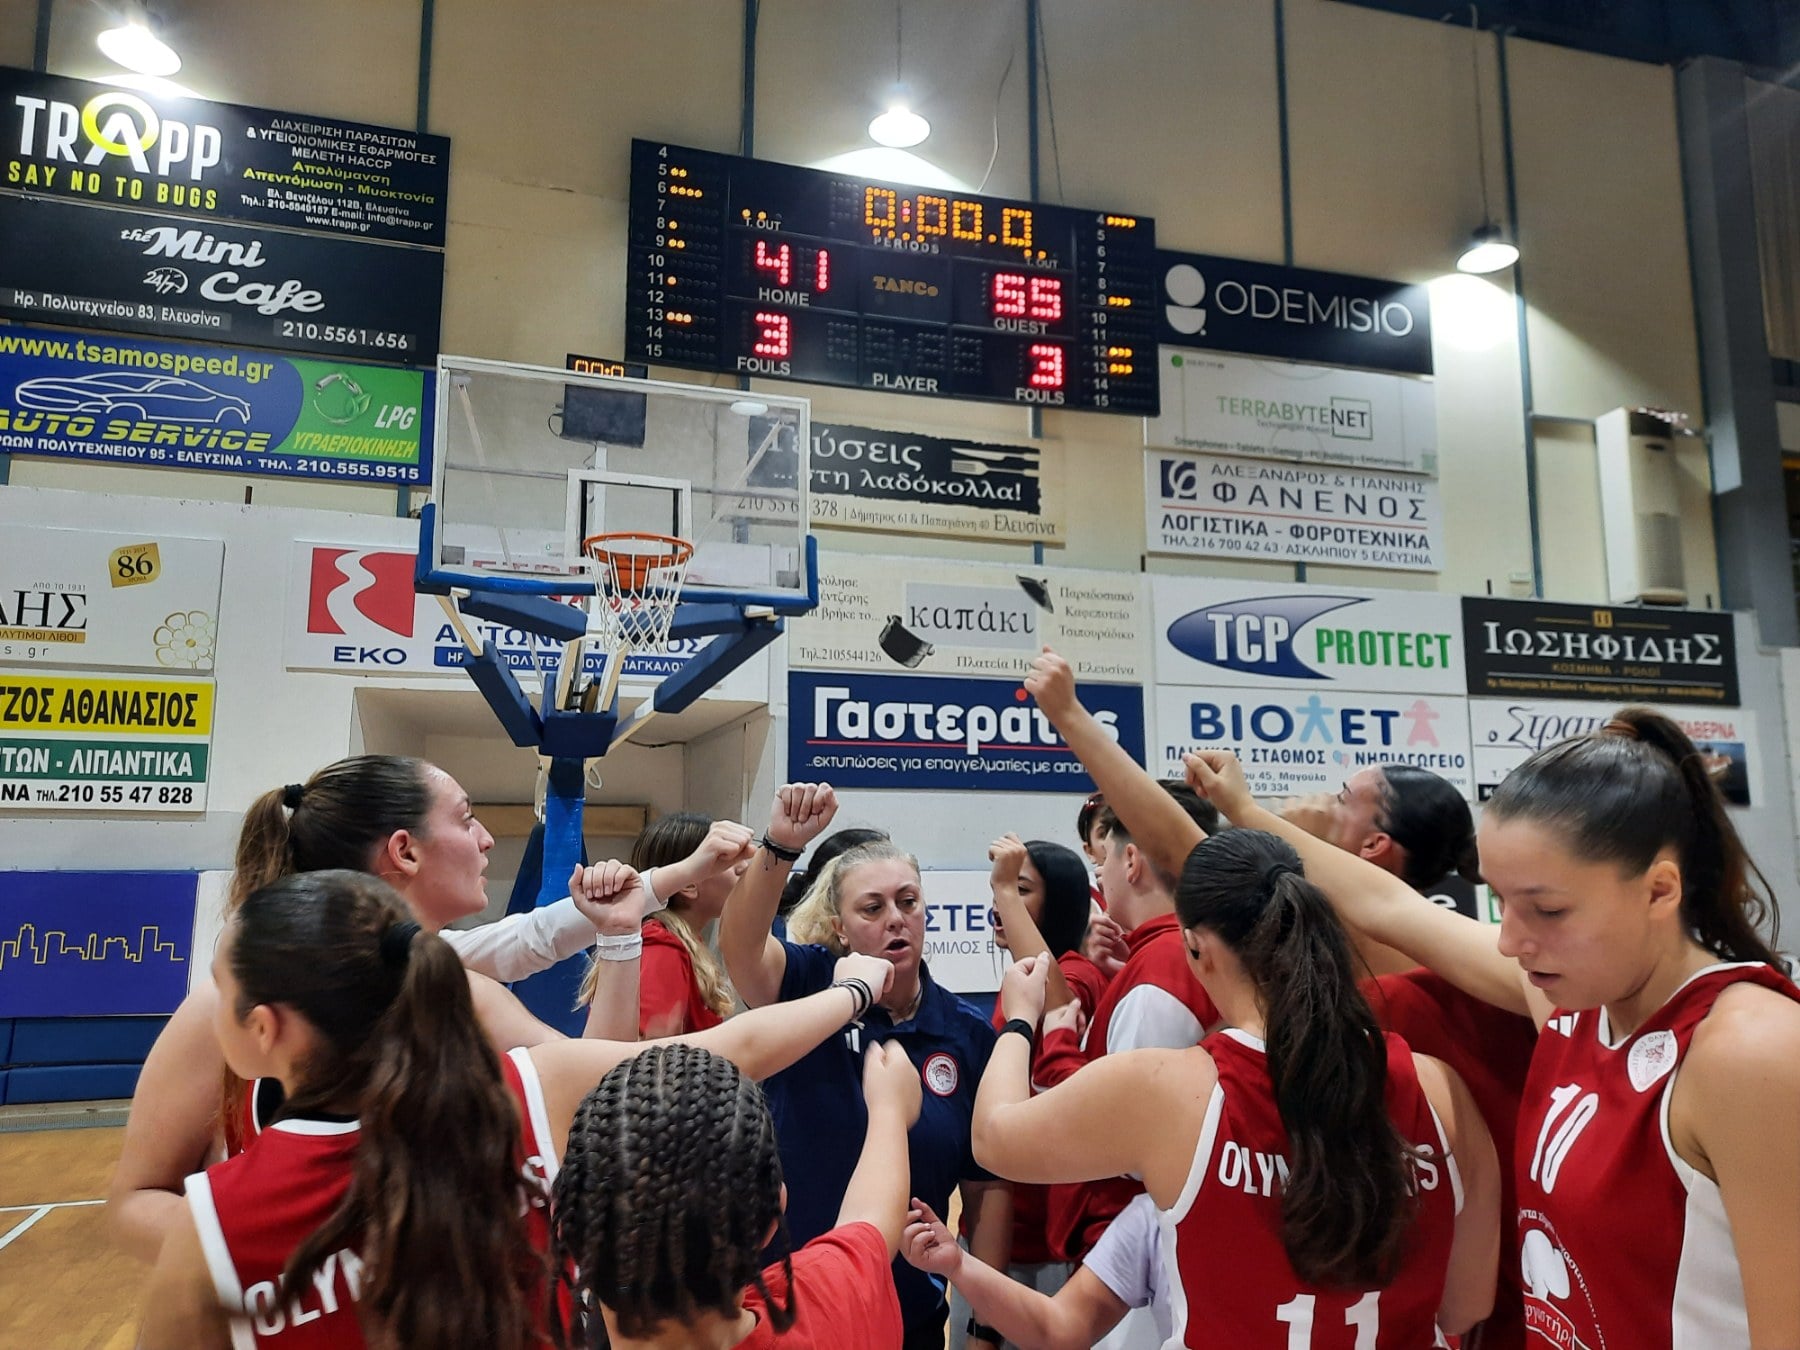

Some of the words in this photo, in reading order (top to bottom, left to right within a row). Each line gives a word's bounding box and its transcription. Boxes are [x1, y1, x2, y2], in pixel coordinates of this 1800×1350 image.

[15, 92, 222, 181] TRAPP
[270, 119, 343, 138] ΔΙΑΧΕΙΡΙΣΗ
[345, 130, 417, 150] ΠΑΡΑΣΙΤΩΝ
[259, 129, 356, 152] ΥΓΕΙΟΝΟΜΙΚΕΣ
[359, 145, 437, 165] ΕΦΑΡΜΟΓΕΣ
[291, 146, 345, 163] ΜΕΛΕΤΗ
[658, 147, 668, 158] 4
[292, 161, 391, 186] Απολύμανση
[658, 164, 667, 176] 5
[8, 161, 57, 188] SAY
[70, 169, 102, 194] NO
[115, 176, 143, 200] TO
[157, 182, 218, 210] BUGS
[243, 167, 344, 193] Απεντόμωση
[357, 184, 435, 204] Μυοκτονία
[657, 182, 667, 194] 6
[657, 199, 666, 211] 7
[656, 217, 666, 229] 8
[655, 235, 665, 247] 9
[1097, 230, 1105, 241] 5
[120, 229, 151, 243] the
[143, 227, 266, 267] Mini
[1097, 246, 1105, 257] 6
[648, 254, 665, 267] 10
[756, 240, 828, 292] 41
[1097, 261, 1106, 273] 7
[648, 272, 664, 285] 11
[1098, 278, 1106, 289] 8
[200, 271, 325, 315] Cafe
[647, 290, 664, 303] 12
[758, 287, 810, 307] HOME
[994, 272, 1062, 319] 55
[42, 294, 134, 317] Πολυτεχνείου
[161, 308, 221, 327] Ελευσίνα
[646, 308, 664, 320] 13
[1091, 312, 1107, 324] 10
[1215, 280, 1414, 337] ODEMISIO
[282, 321, 408, 350] 210.5561.656
[646, 326, 663, 339] 14
[755, 312, 789, 357] 3
[994, 318, 1049, 336] GUEST
[1092, 329, 1107, 340] 11
[645, 344, 663, 357] 15
[737, 356, 791, 375] FOULS
[1030, 344, 1063, 387] 3
[872, 372, 939, 393] PLAYER
[1093, 378, 1109, 390] 14
[1015, 388, 1065, 405] FOULS
[1093, 395, 1109, 407] 15
[374, 404, 417, 430] LPG
[102, 419, 272, 453] SERVICE
[292, 432, 418, 459] ΥΓΡΑΕΡΙΟΚΙΝΗΣΗ
[37, 438, 146, 458] ΠΟΛΥΤΕΧΝΕΙΟΥ
[150, 449, 165, 460] 95
[177, 450, 243, 466] ΕΛΕΥΣΙΝΑ
[297, 459, 419, 480] 210.555.9515
[860, 469, 1022, 501] λαδόκολλα!
[1211, 463, 1328, 486] ΑΛΕΞΑΝΔΡΟΣ
[1351, 475, 1426, 494] ΓΙΑΝΝΗΣ
[812, 499, 838, 517] 378
[1212, 481, 1427, 522] ΦΑΝΕΝΟΣ
[993, 514, 1056, 536] Ελευσίνα
[1161, 514, 1269, 538] ΛΟΓΙΣΤΙΚΑ
[1289, 524, 1431, 550] ΦΟΡΟΤΕΧΝΙΚΑ
[117, 552, 153, 578] 86
[1372, 550, 1432, 566] ΕΛΕΥΣΙΝΑ
[910, 601, 1035, 634] καπάκι
[1206, 612, 1290, 664] TCP
[1315, 628, 1452, 669] PROTECT
[1482, 621, 1723, 667] ΙΩΣΗΦΙΔΗΣ
[334, 646, 408, 665] EKO
[956, 656, 1009, 670] Πλατεία
[59, 689, 199, 728] ΑΘΑΝΑΣΙΟΣ
[68, 748, 193, 777] ΛΙΠΑΝΤΙΚΑ
[901, 757, 922, 772] για
[925, 757, 1031, 775] επαγγελματίες
[1032, 761, 1051, 775] με
[1251, 748, 1326, 765] ΣΤΑΘΜΟΣ
[100, 786, 123, 803] 55
[129, 787, 152, 803] 47
[159, 787, 193, 804] 828
[1530, 1083, 1599, 1194] 10
